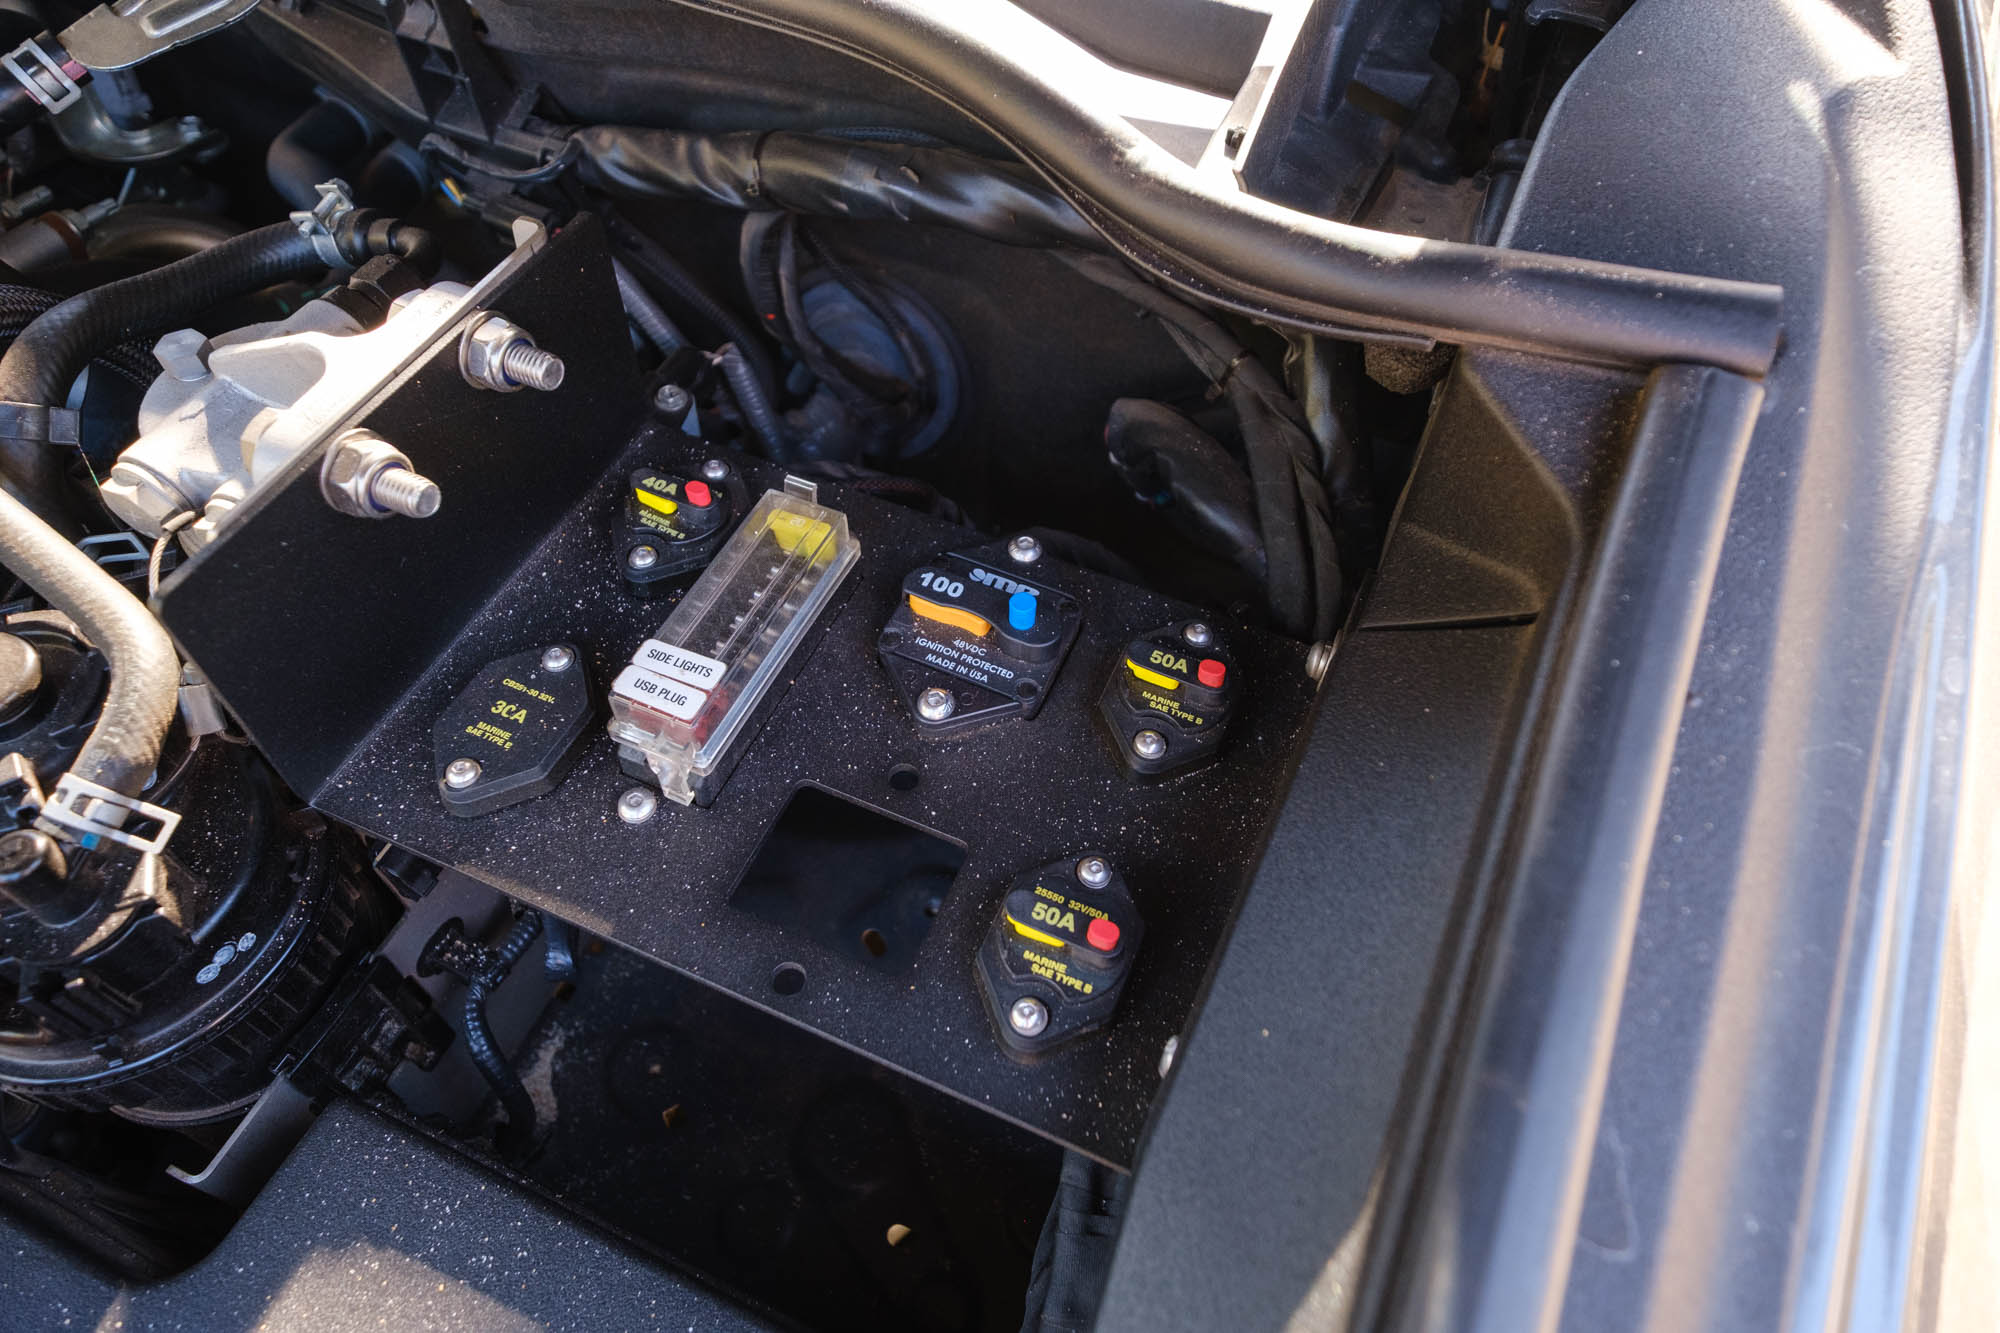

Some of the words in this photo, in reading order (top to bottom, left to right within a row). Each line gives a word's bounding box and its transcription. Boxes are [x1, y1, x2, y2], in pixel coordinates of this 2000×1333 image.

[641, 476, 678, 496] 40A
[920, 571, 965, 598] 100
[915, 636, 960, 659] IGNITION
[960, 654, 1014, 679] PROTECTED
[953, 639, 988, 656] 48VDC
[647, 648, 675, 665] SIDE
[673, 657, 713, 678] LIGHTS
[925, 653, 956, 670] MADE
[956, 664, 969, 675] IN
[969, 669, 988, 683] USA
[1150, 650, 1188, 674] 50A
[633, 678, 658, 694] USB
[657, 687, 688, 706] PLUG
[1142, 690, 1181, 710] MARINE
[1149, 701, 1169, 713] SAE
[1170, 709, 1195, 722] TYPE
[465, 725, 484, 737] SAE
[482, 732, 505, 746] TYPE
[476, 721, 512, 740] MARINE
[1034, 886, 1065, 905] 25550
[1067, 899, 1109, 921] 32V/50A
[1031, 901, 1075, 933] 50A
[1023, 950, 1068, 974] MARINE
[1031, 963, 1053, 979] SAE
[1055, 972, 1083, 991] TYPE
[1083, 983, 1094, 995] B
